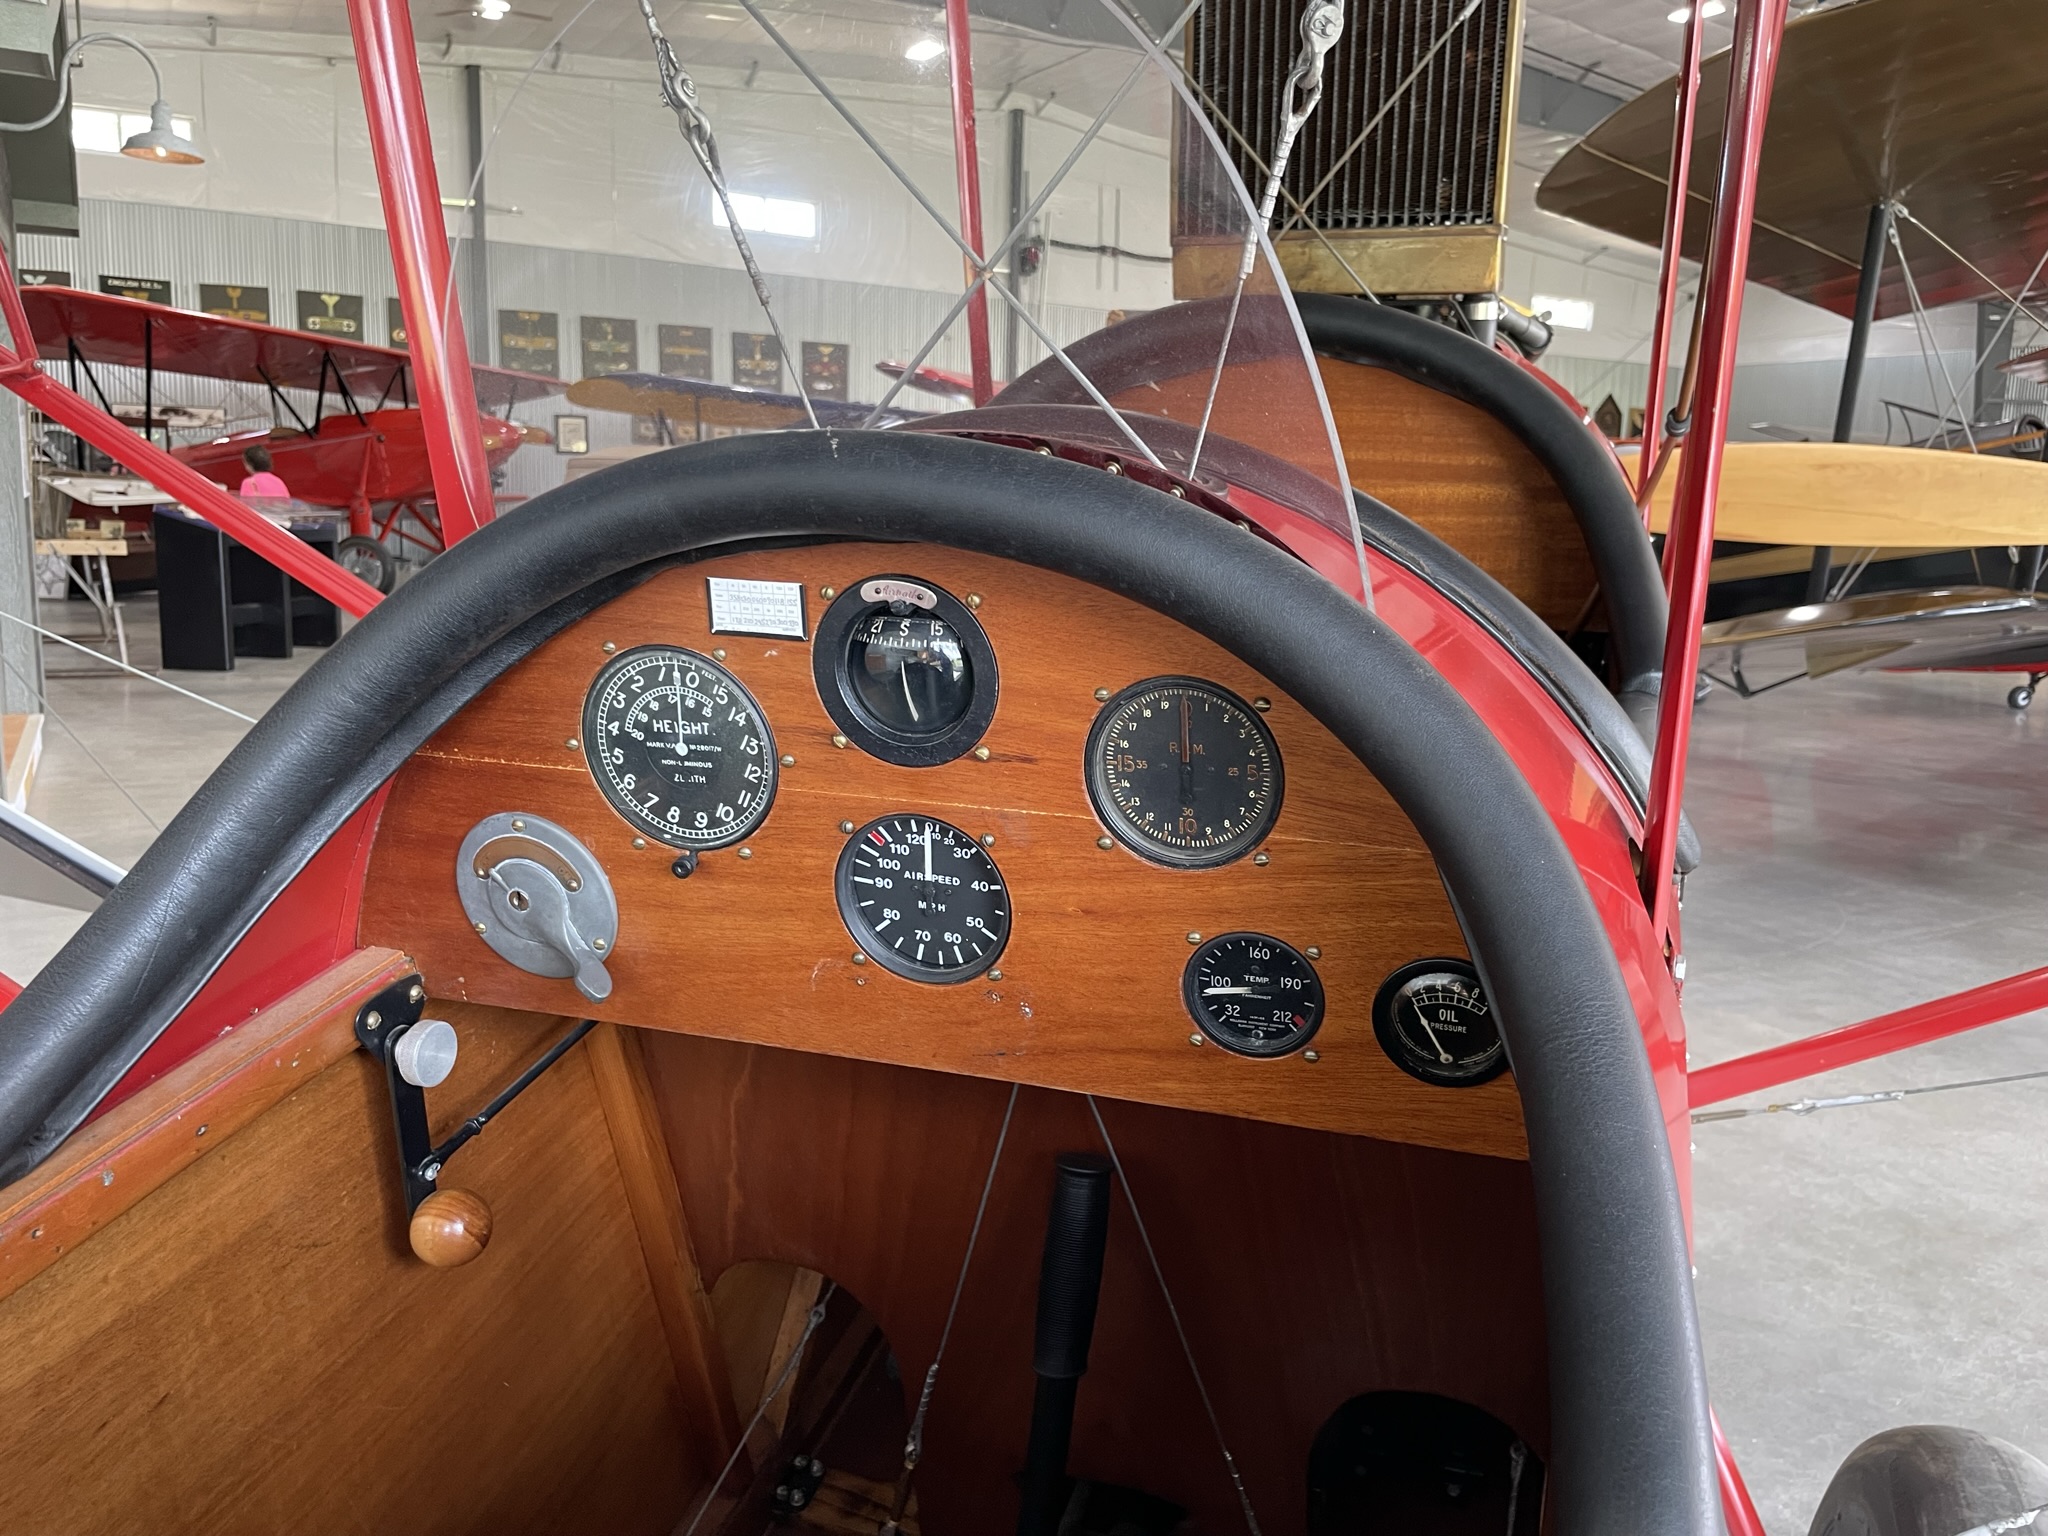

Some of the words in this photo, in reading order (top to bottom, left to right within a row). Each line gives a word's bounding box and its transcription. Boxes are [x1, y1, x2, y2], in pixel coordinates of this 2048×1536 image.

[870, 619, 884, 634] 21
[930, 620, 944, 636] 15
[658, 667, 665, 681] 1
[686, 671, 699, 688] 0
[631, 675, 644, 693] 2
[613, 692, 626, 709] 3
[668, 694, 678, 704] 17
[712, 685, 729, 704] 15
[649, 700, 659, 711] 18
[685, 698, 695, 708] 16
[1161, 701, 1169, 710] 19
[1205, 703, 1208, 711] 1
[638, 712, 648, 722] 19
[702, 707, 712, 718] 15
[728, 707, 747, 727] 14
[1143, 709, 1151, 718] 18
[1224, 715, 1229, 723] 2
[607, 721, 620, 736] 4
[1129, 722, 1137, 731] 17
[631, 729, 644, 741] 20
[1239, 729, 1246, 738] 3
[740, 735, 759, 755] 13
[1120, 740, 1129, 748] 16
[612, 748, 624, 764] 5
[1117, 754, 1135, 772] 15
[1136, 760, 1148, 768] 35
[744, 763, 761, 783] 12
[1228, 768, 1239, 776] 25
[1247, 765, 1259, 781] 5
[624, 774, 636, 790] 6
[674, 773, 706, 784] ZITH
[1121, 779, 1130, 788] 14
[738, 790, 751, 807] 11
[1249, 790, 1255, 798] 6
[644, 792, 659, 809] 7
[1131, 797, 1140, 806] 13
[667, 806, 680, 823] 8
[716, 803, 734, 822] 10
[1146, 813, 1154, 821] 12
[1182, 808, 1193, 816] 30
[694, 812, 708, 828] 9
[1179, 817, 1197, 834] 10
[1224, 820, 1230, 828] 8
[1164, 823, 1171, 831] 11
[905, 834, 926, 845] 120
[944, 838, 955, 846] 20
[889, 844, 910, 856] 110
[953, 848, 971, 859] 30
[877, 858, 901, 871] 100
[874, 877, 893, 889] 90
[904, 870, 960, 886] AIRPEED
[971, 881, 989, 892] 40
[883, 908, 900, 920] 80
[966, 916, 984, 928] 50
[914, 930, 931, 941] 70
[944, 932, 962, 944] 60
[1250, 946, 1270, 960] 160
[1211, 975, 1231, 987] 100
[1280, 977, 1301, 990] 190
[1454, 982, 1460, 992] 6
[1472, 988, 1480, 998] 8
[1225, 1004, 1240, 1016] 32
[1439, 1009, 1458, 1022] OIL
[1273, 1011, 1292, 1023] 212
[1430, 1022, 1467, 1034] PRESSURE
